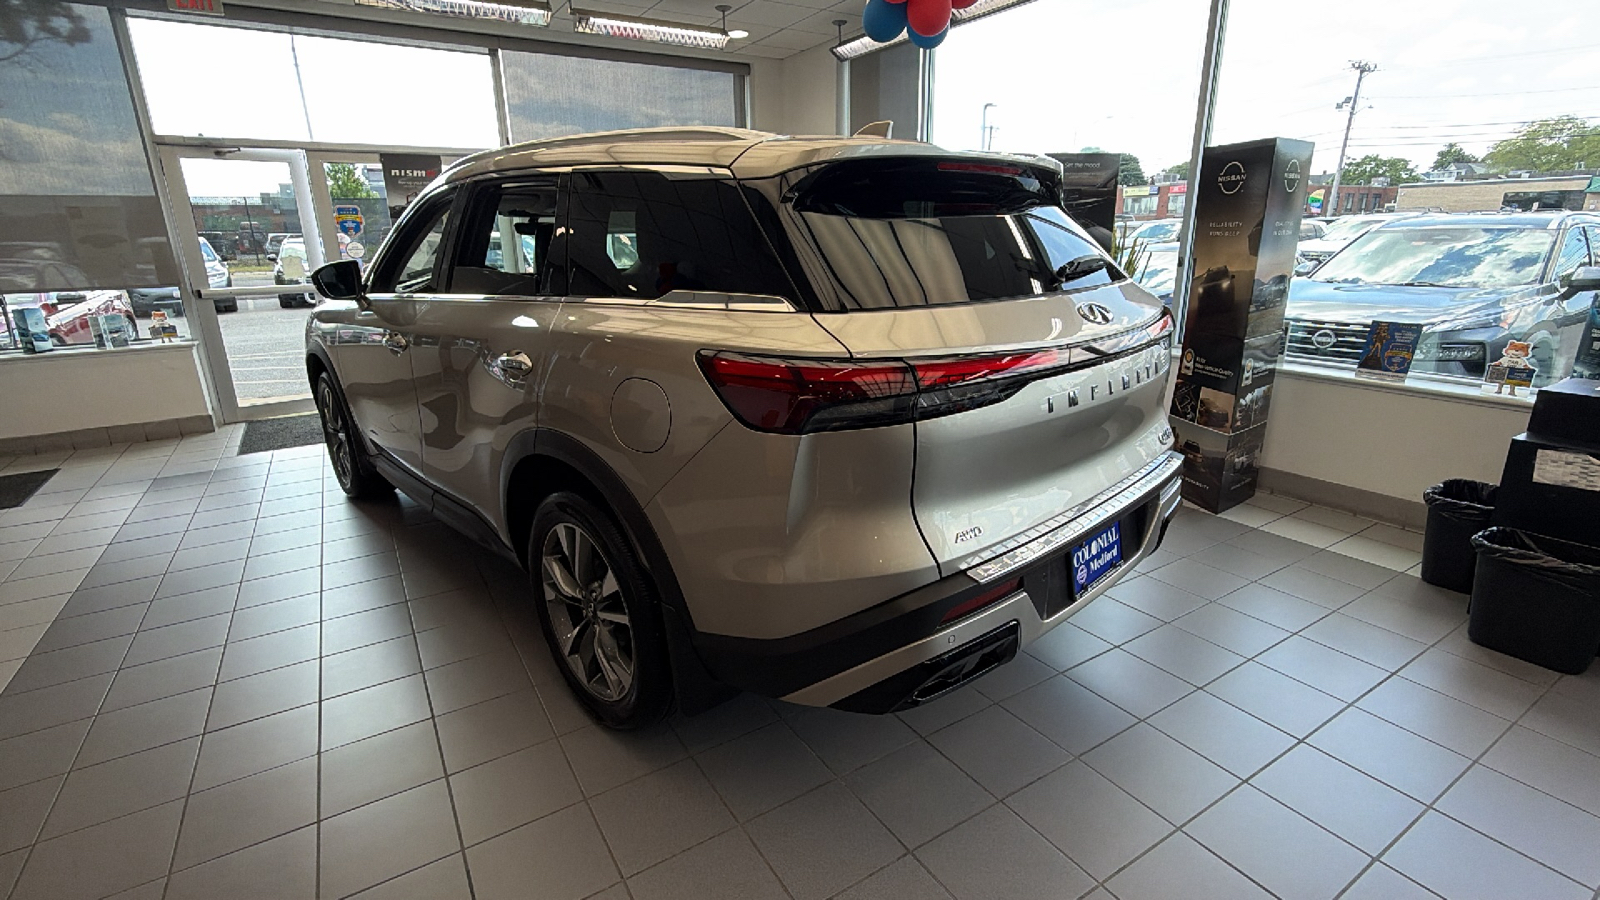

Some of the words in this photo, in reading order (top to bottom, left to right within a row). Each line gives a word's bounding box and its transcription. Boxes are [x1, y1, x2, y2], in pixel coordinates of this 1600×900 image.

[1217, 173, 1247, 183] NISSAN
[1047, 361, 1159, 414] INFINITI
[954, 525, 984, 544] AWD
[1073, 526, 1119, 568] COLONIAL
[1089, 544, 1118, 573] Medford
